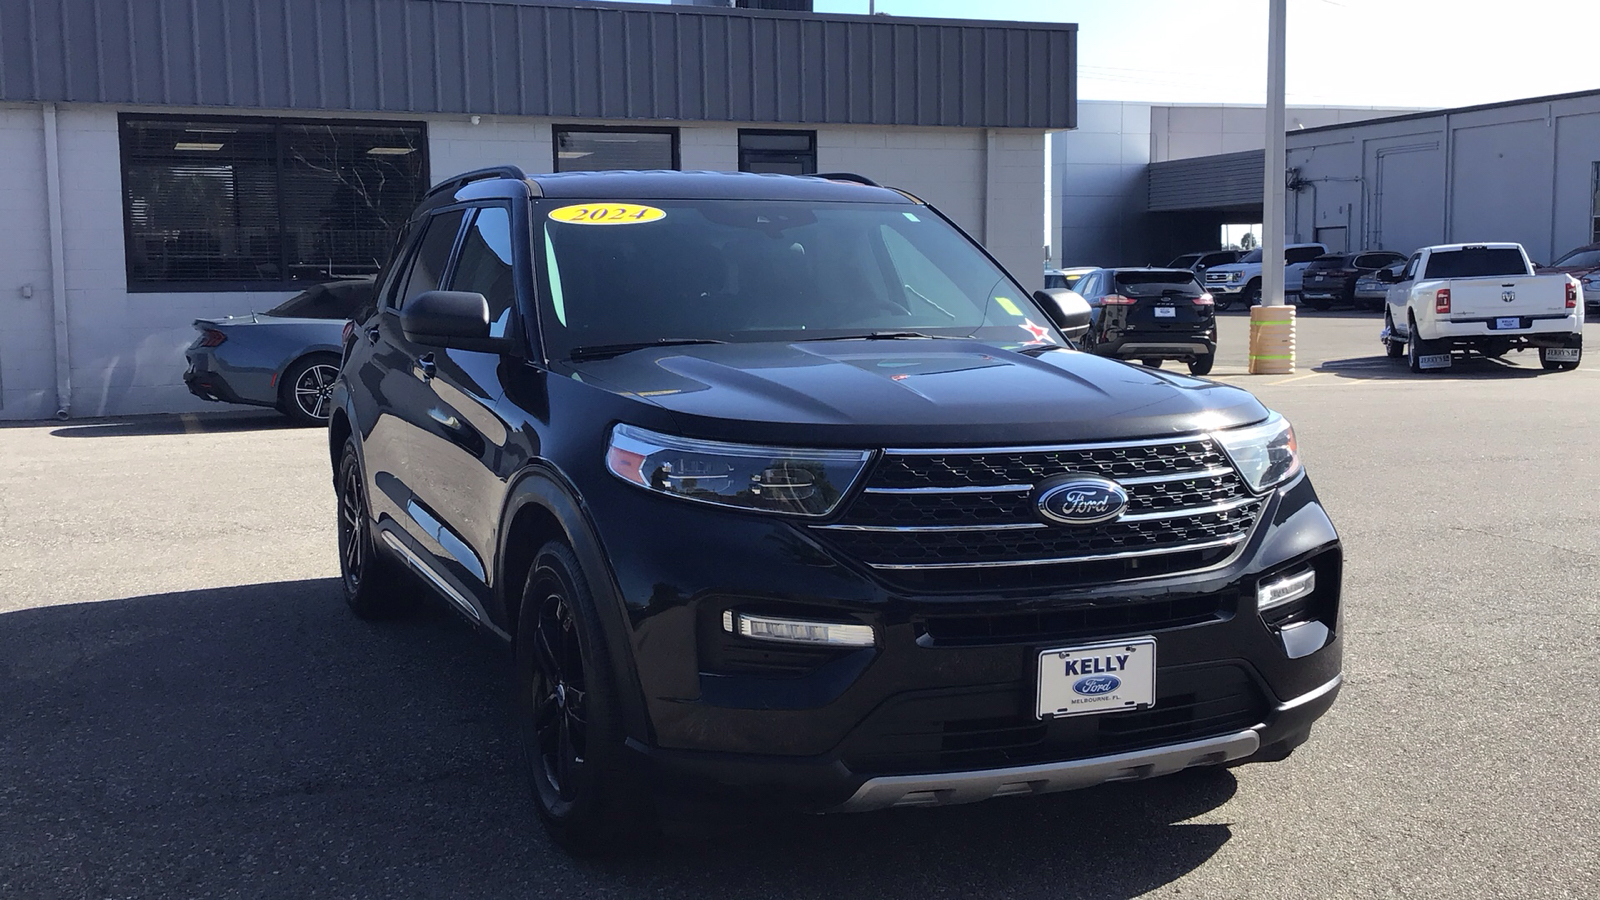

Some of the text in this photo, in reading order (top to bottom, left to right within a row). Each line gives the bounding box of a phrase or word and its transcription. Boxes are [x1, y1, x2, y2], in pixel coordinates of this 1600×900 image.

[570, 208, 648, 221] 2024
[1062, 490, 1109, 514] Ford
[1065, 655, 1129, 676] KELLY
[1082, 678, 1111, 693] Ford
